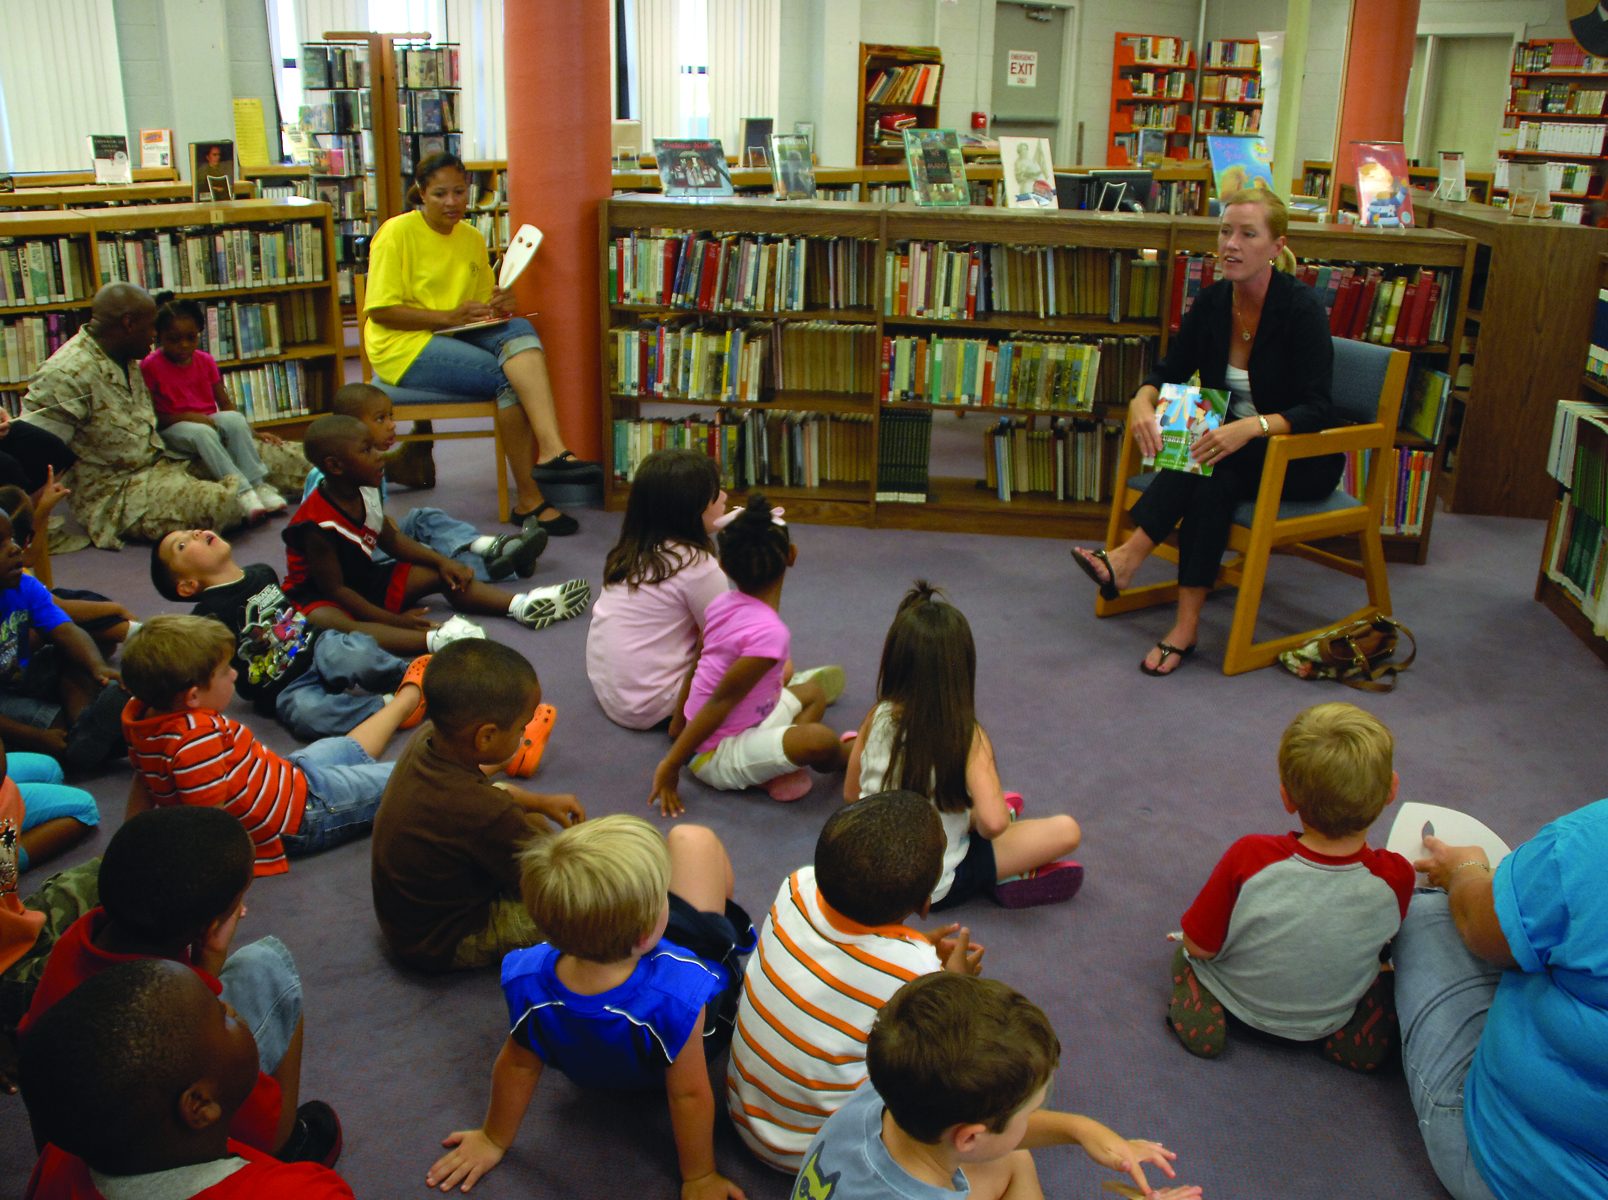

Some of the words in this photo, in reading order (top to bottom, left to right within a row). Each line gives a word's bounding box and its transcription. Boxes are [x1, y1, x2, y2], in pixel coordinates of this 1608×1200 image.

[1011, 62, 1035, 75] EXIT
[663, 141, 691, 149] Cuban
[694, 141, 713, 149] Kids
